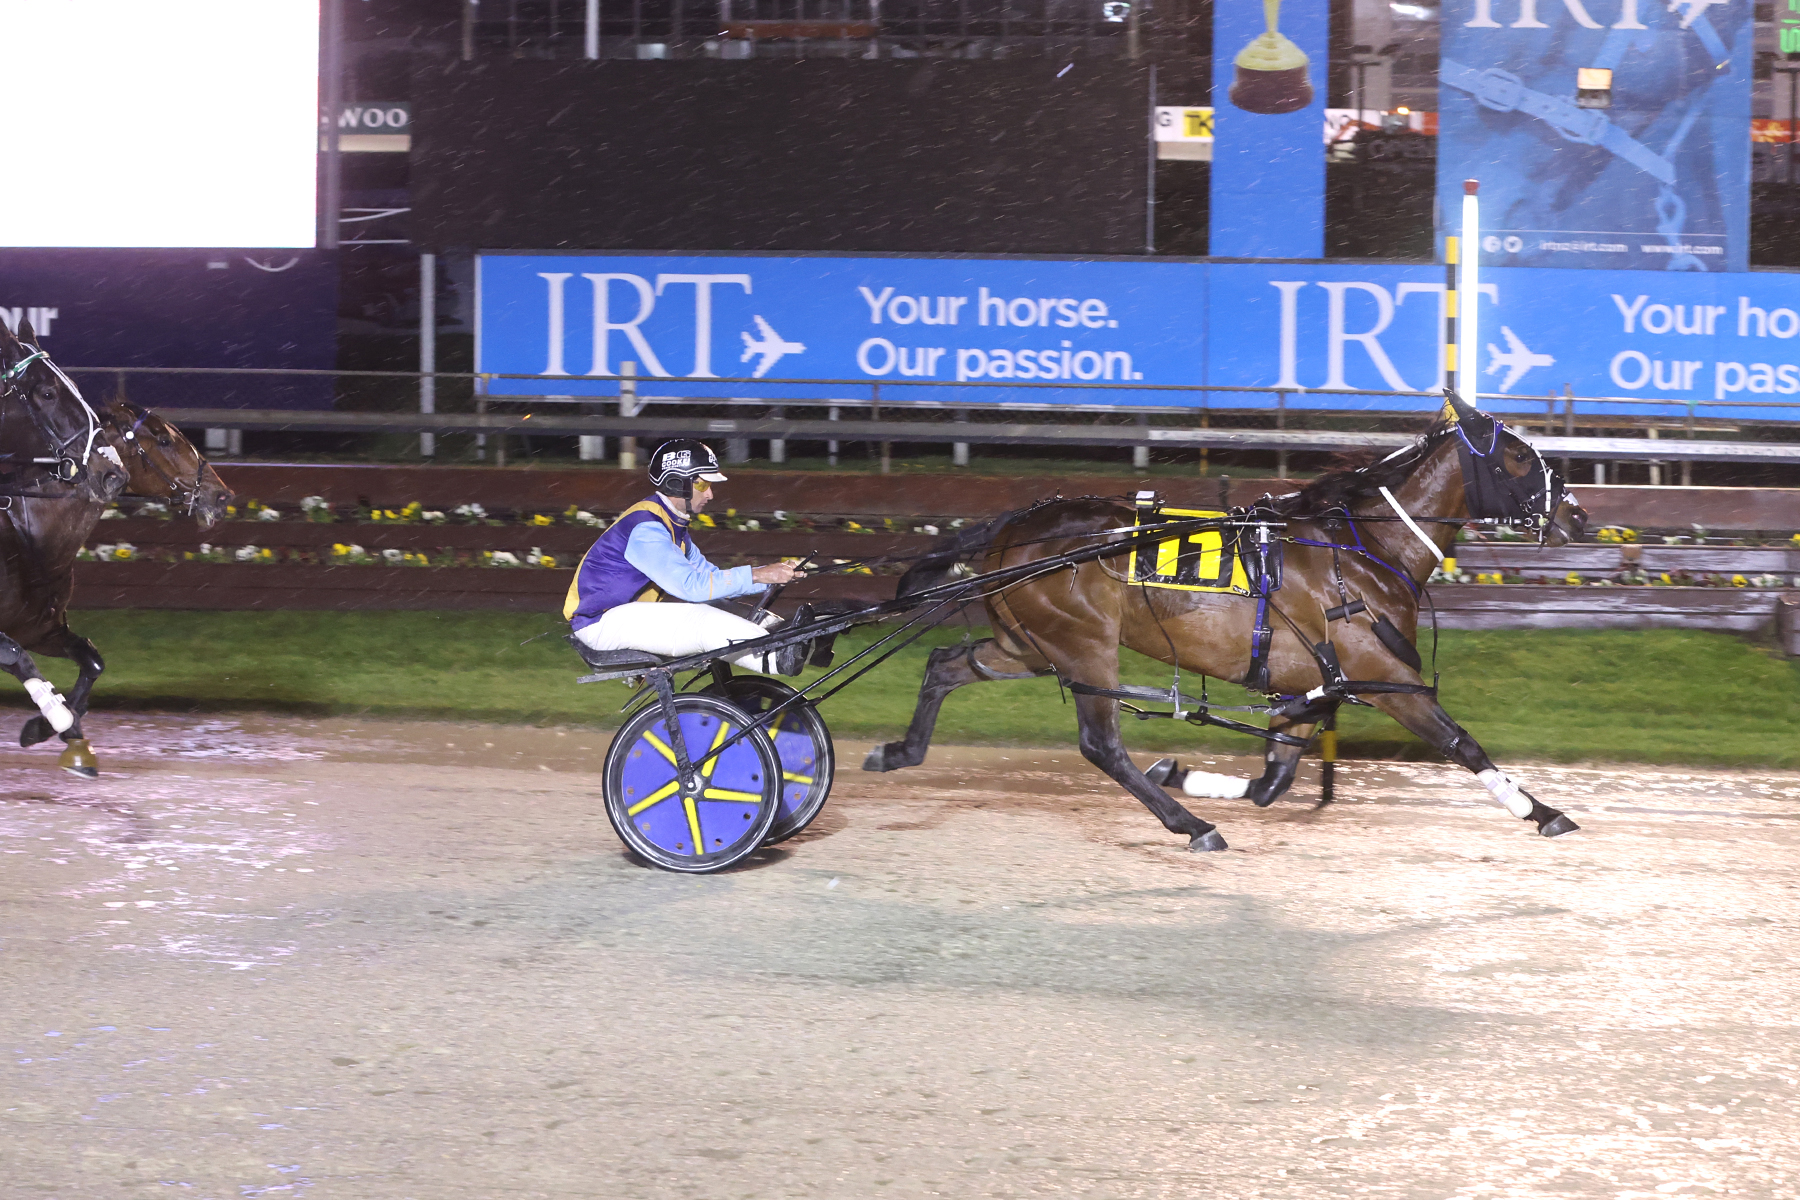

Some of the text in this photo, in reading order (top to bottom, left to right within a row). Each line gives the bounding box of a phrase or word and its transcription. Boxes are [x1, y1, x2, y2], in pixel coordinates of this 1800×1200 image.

[536, 272, 753, 378] IRT
[857, 286, 1119, 329] Your horse.
[1610, 293, 1800, 339] Your ho
[856, 337, 1144, 382] Our passion.
[1268, 280, 1499, 393] IRT
[1609, 350, 1800, 400] Our pas
[1147, 519, 1222, 580] 11
